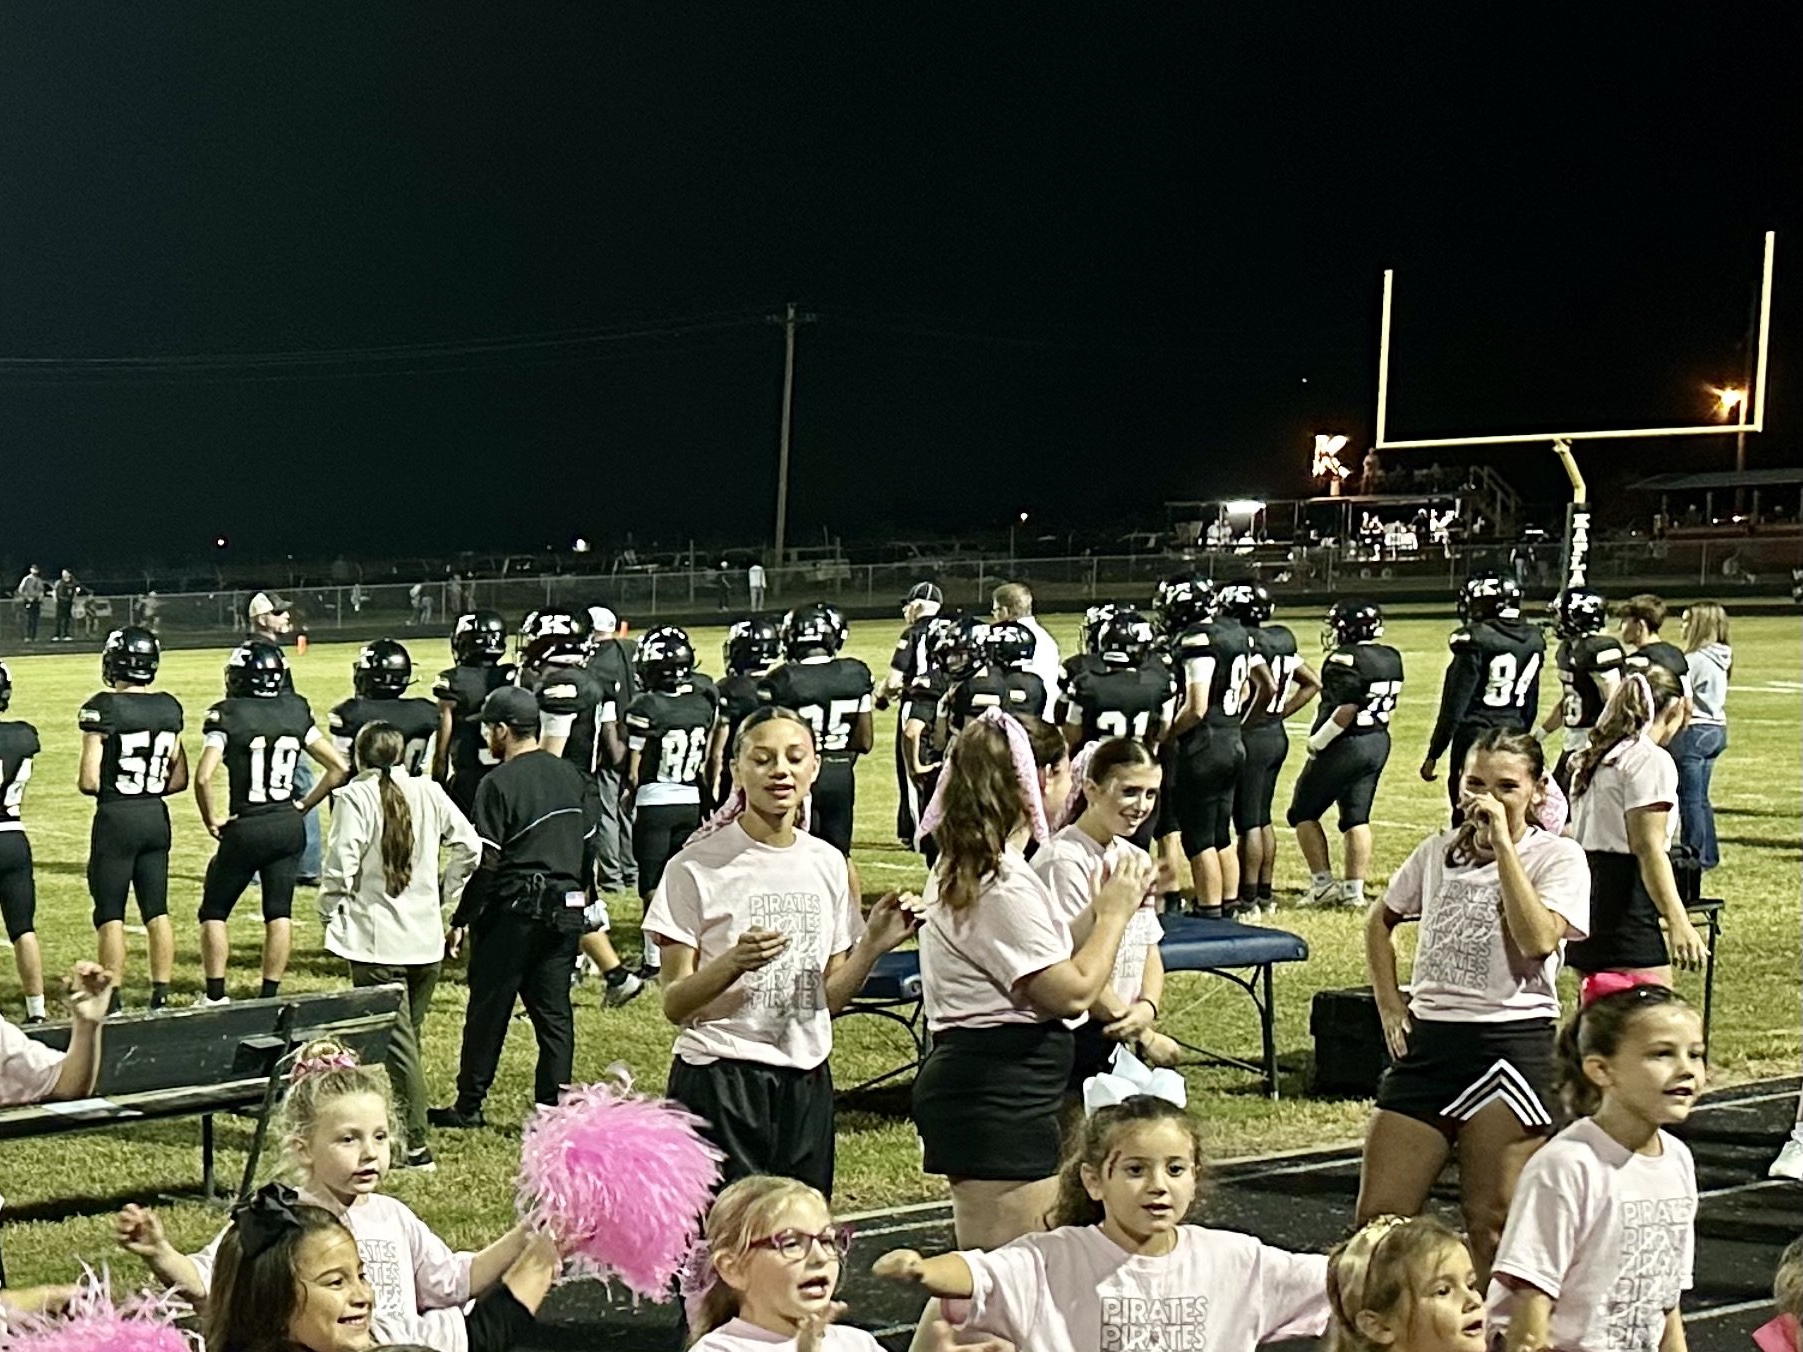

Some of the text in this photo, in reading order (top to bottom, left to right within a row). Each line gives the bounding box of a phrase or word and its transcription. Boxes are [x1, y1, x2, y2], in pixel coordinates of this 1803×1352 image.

[1312, 434, 1352, 479] K
[1568, 513, 1590, 588] KAPLA
[538, 614, 571, 635] K
[247, 735, 301, 803] 18
[749, 891, 821, 915] PIRATES
[356, 1238, 398, 1264] ATES
[1101, 1294, 1209, 1325] PIRATES
[1100, 1322, 1207, 1351] PIRATES
